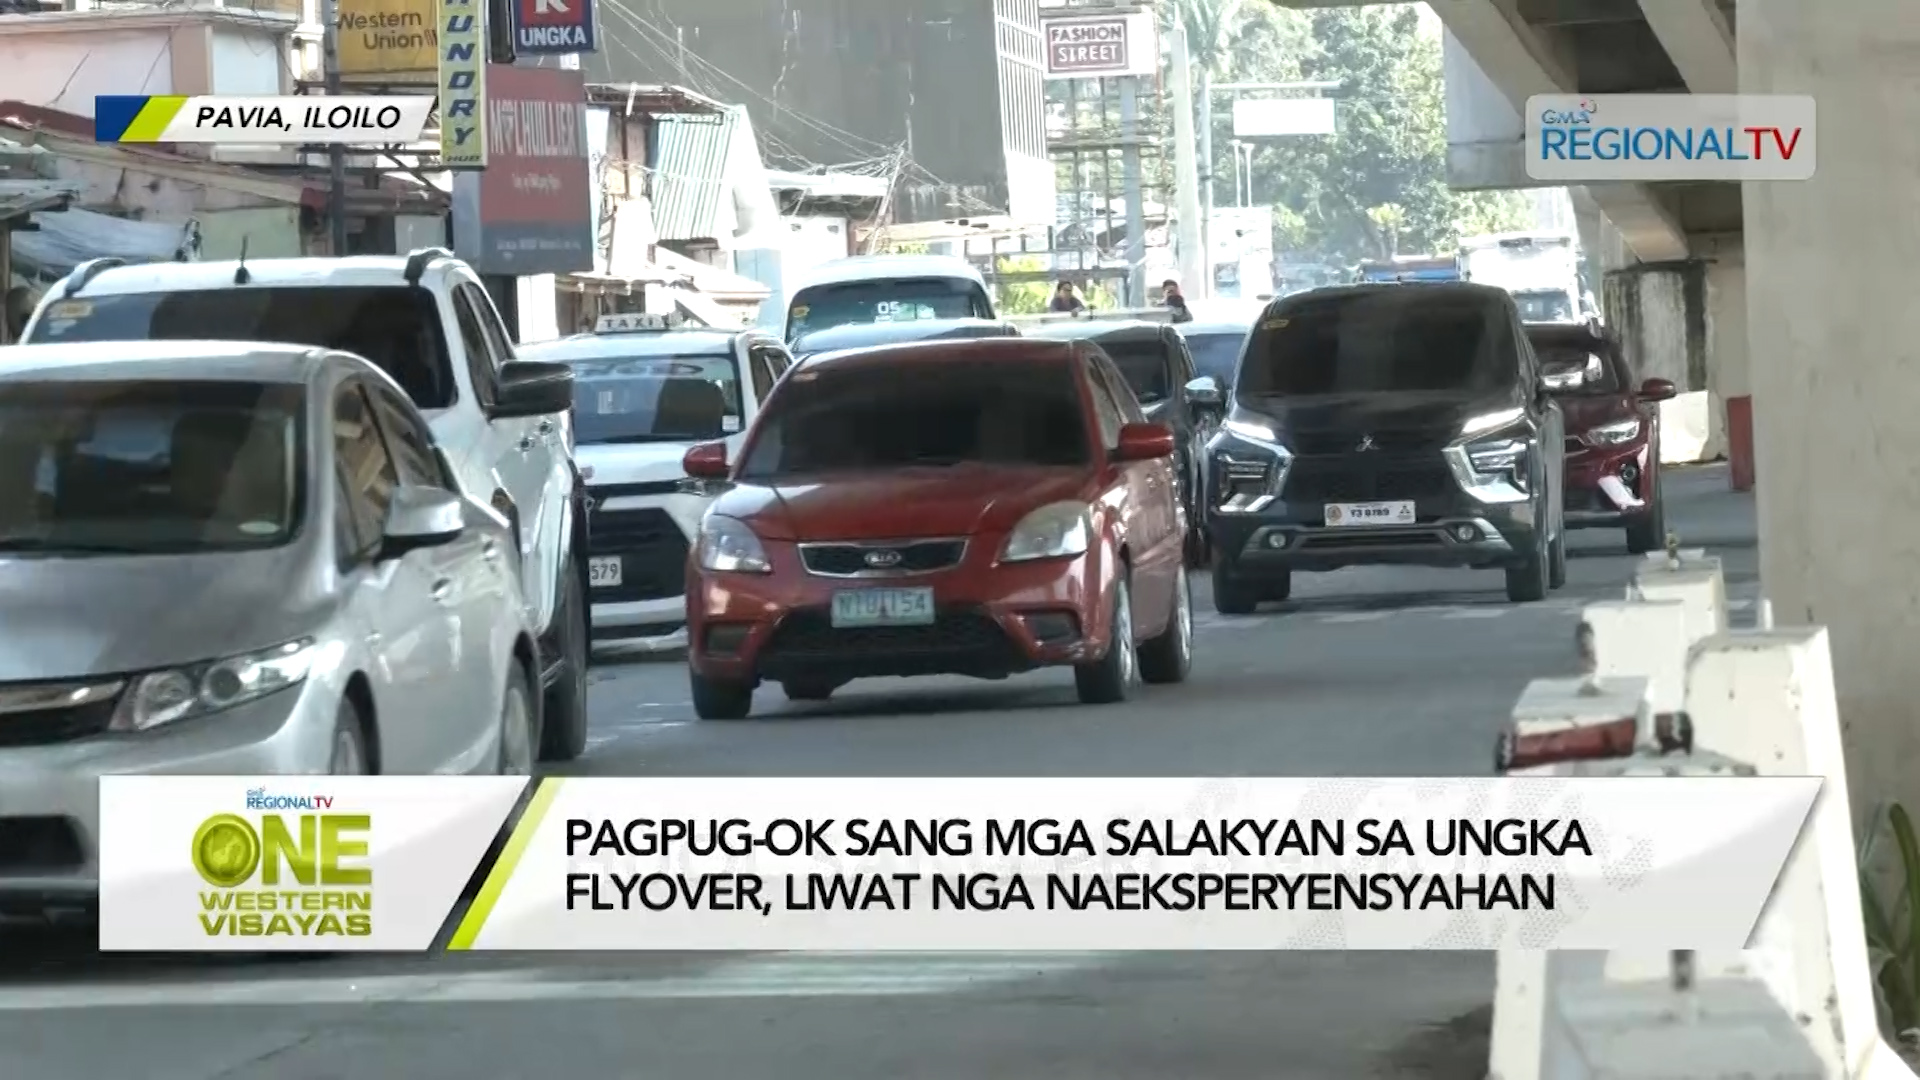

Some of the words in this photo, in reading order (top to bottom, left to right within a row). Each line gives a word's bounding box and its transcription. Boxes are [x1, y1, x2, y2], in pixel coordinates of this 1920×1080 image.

[338, 12, 421, 29] Western
[364, 30, 422, 49] Union
[520, 26, 586, 46] UNGKA
[1052, 26, 1121, 41] FASHION
[1058, 45, 1117, 61] STREET
[446, 0, 476, 145] UNDRY
[605, 319, 653, 328] TAXI
[591, 563, 618, 580] 579
